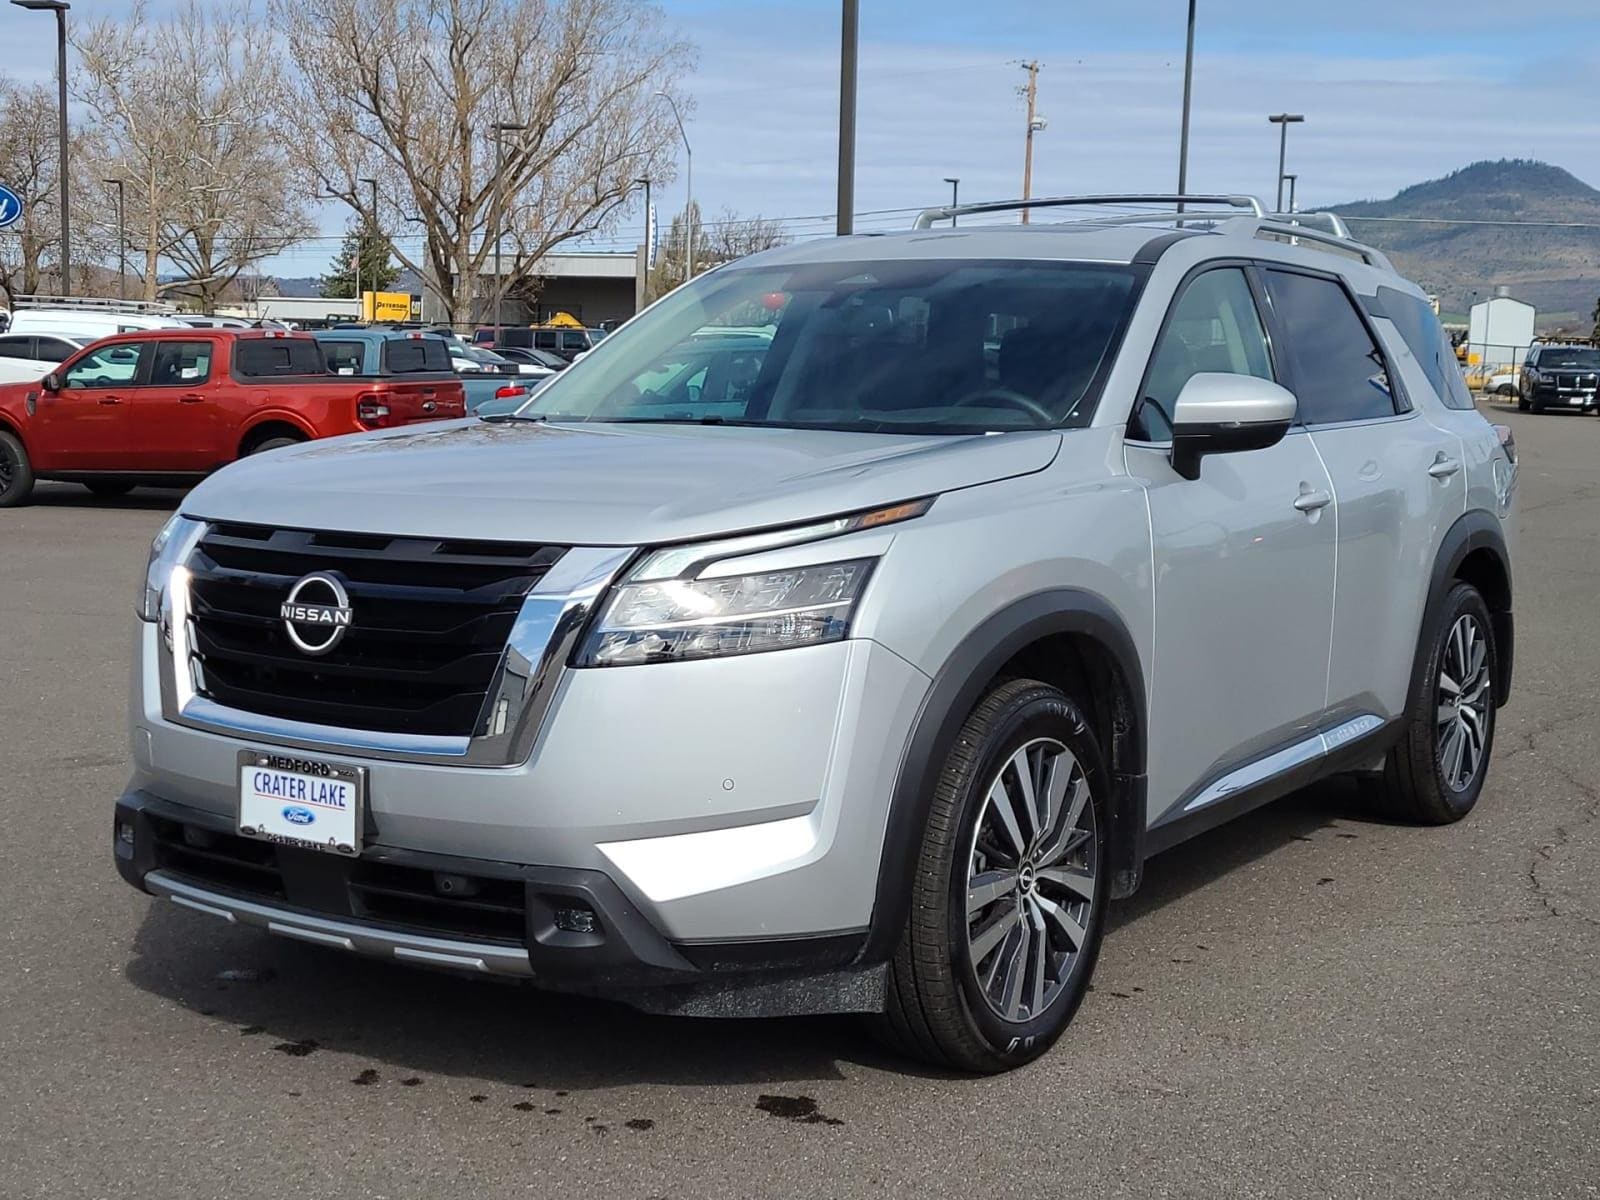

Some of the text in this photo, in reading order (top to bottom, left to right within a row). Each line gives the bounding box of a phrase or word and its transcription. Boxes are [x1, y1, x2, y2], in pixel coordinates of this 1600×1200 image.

[281, 605, 350, 623] NISSAN
[267, 755, 331, 776] MEDFORD
[254, 772, 346, 807] CRATER LAKE
[286, 809, 310, 823] Ford
